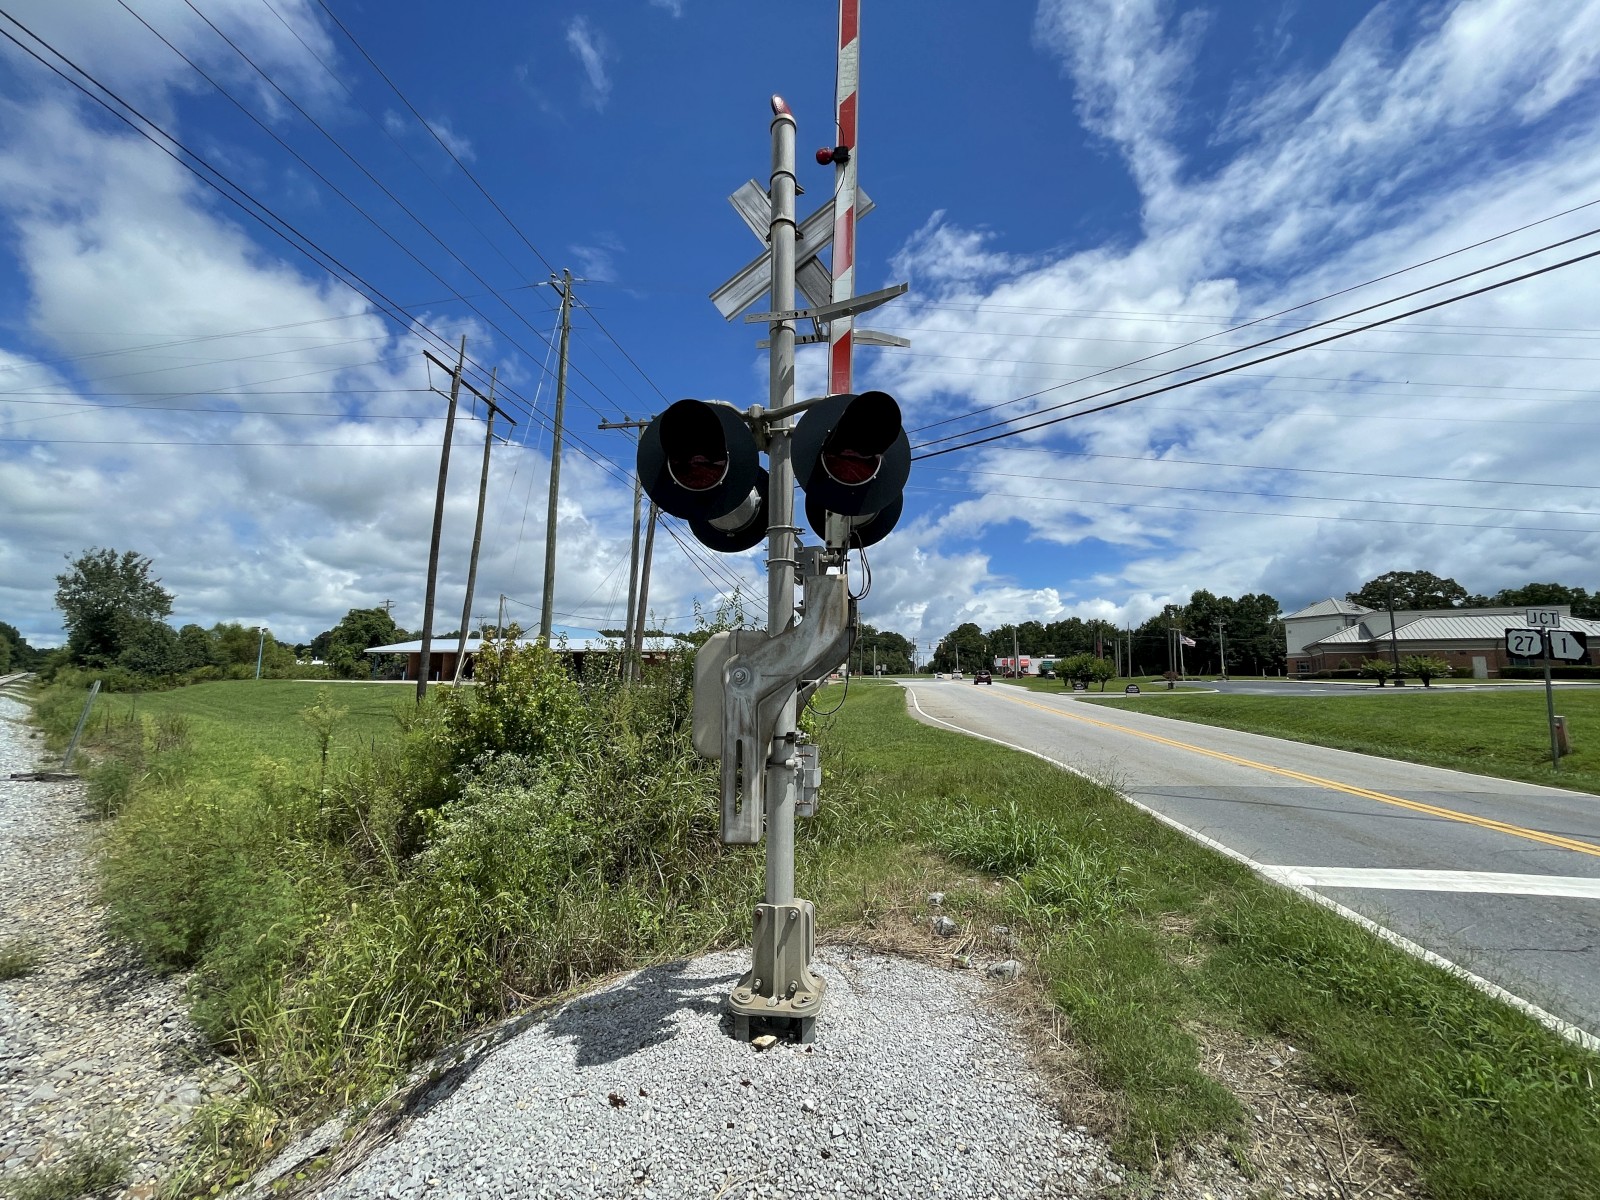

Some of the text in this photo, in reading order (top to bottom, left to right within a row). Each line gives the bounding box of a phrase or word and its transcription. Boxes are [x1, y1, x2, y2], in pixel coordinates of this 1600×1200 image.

[1530, 612, 1557, 625] JCT
[1514, 635, 1534, 652] 27
[1561, 637, 1567, 654] 1
